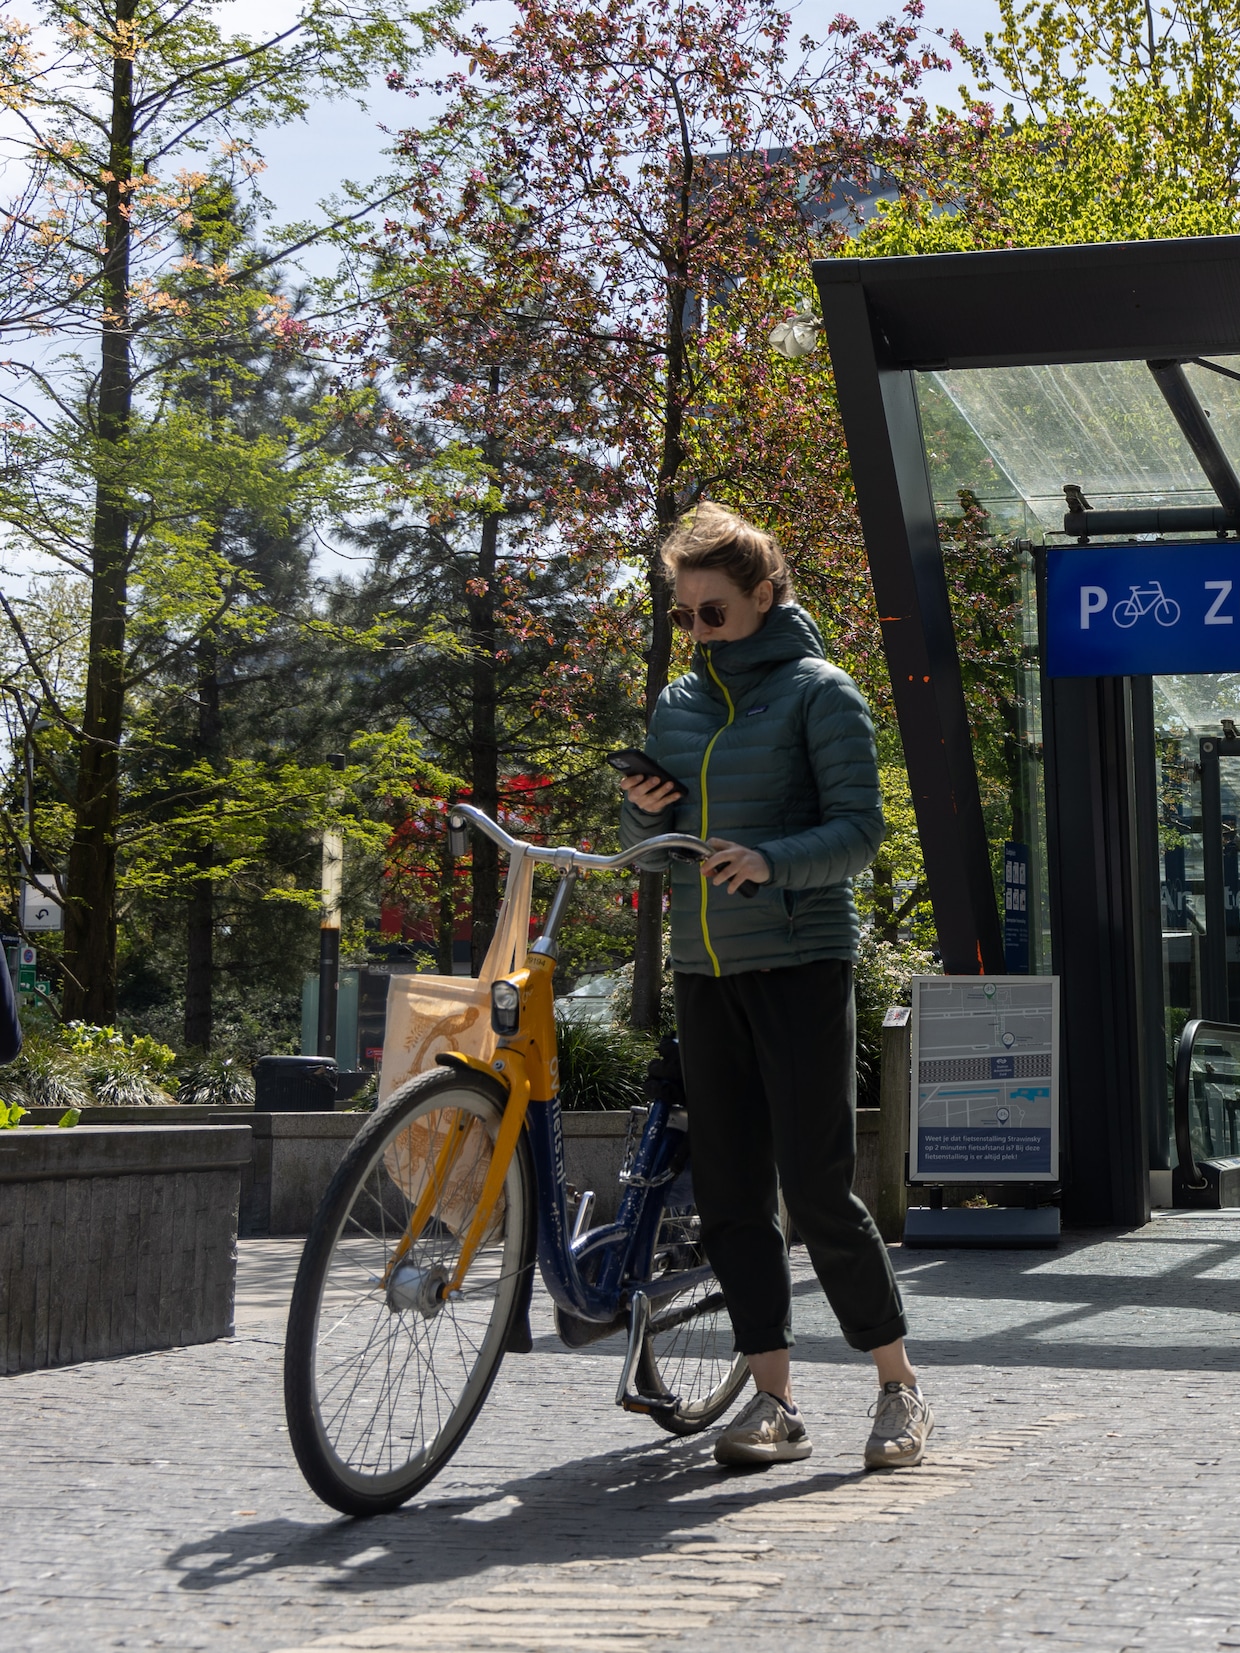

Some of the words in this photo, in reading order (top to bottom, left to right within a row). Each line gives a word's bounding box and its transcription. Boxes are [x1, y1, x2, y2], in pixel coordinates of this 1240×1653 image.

[1080, 585, 1108, 630] P
[943, 1135, 950, 1143] je
[962, 1135, 1007, 1144] fietsenstalling
[1007, 1135, 1041, 1144] Strawinsky
[1015, 1144, 1024, 1152] Bij
[924, 1153, 969, 1162] fietsenstalling
[983, 1153, 1001, 1161] altijd
[1001, 1153, 1018, 1161] plek!
